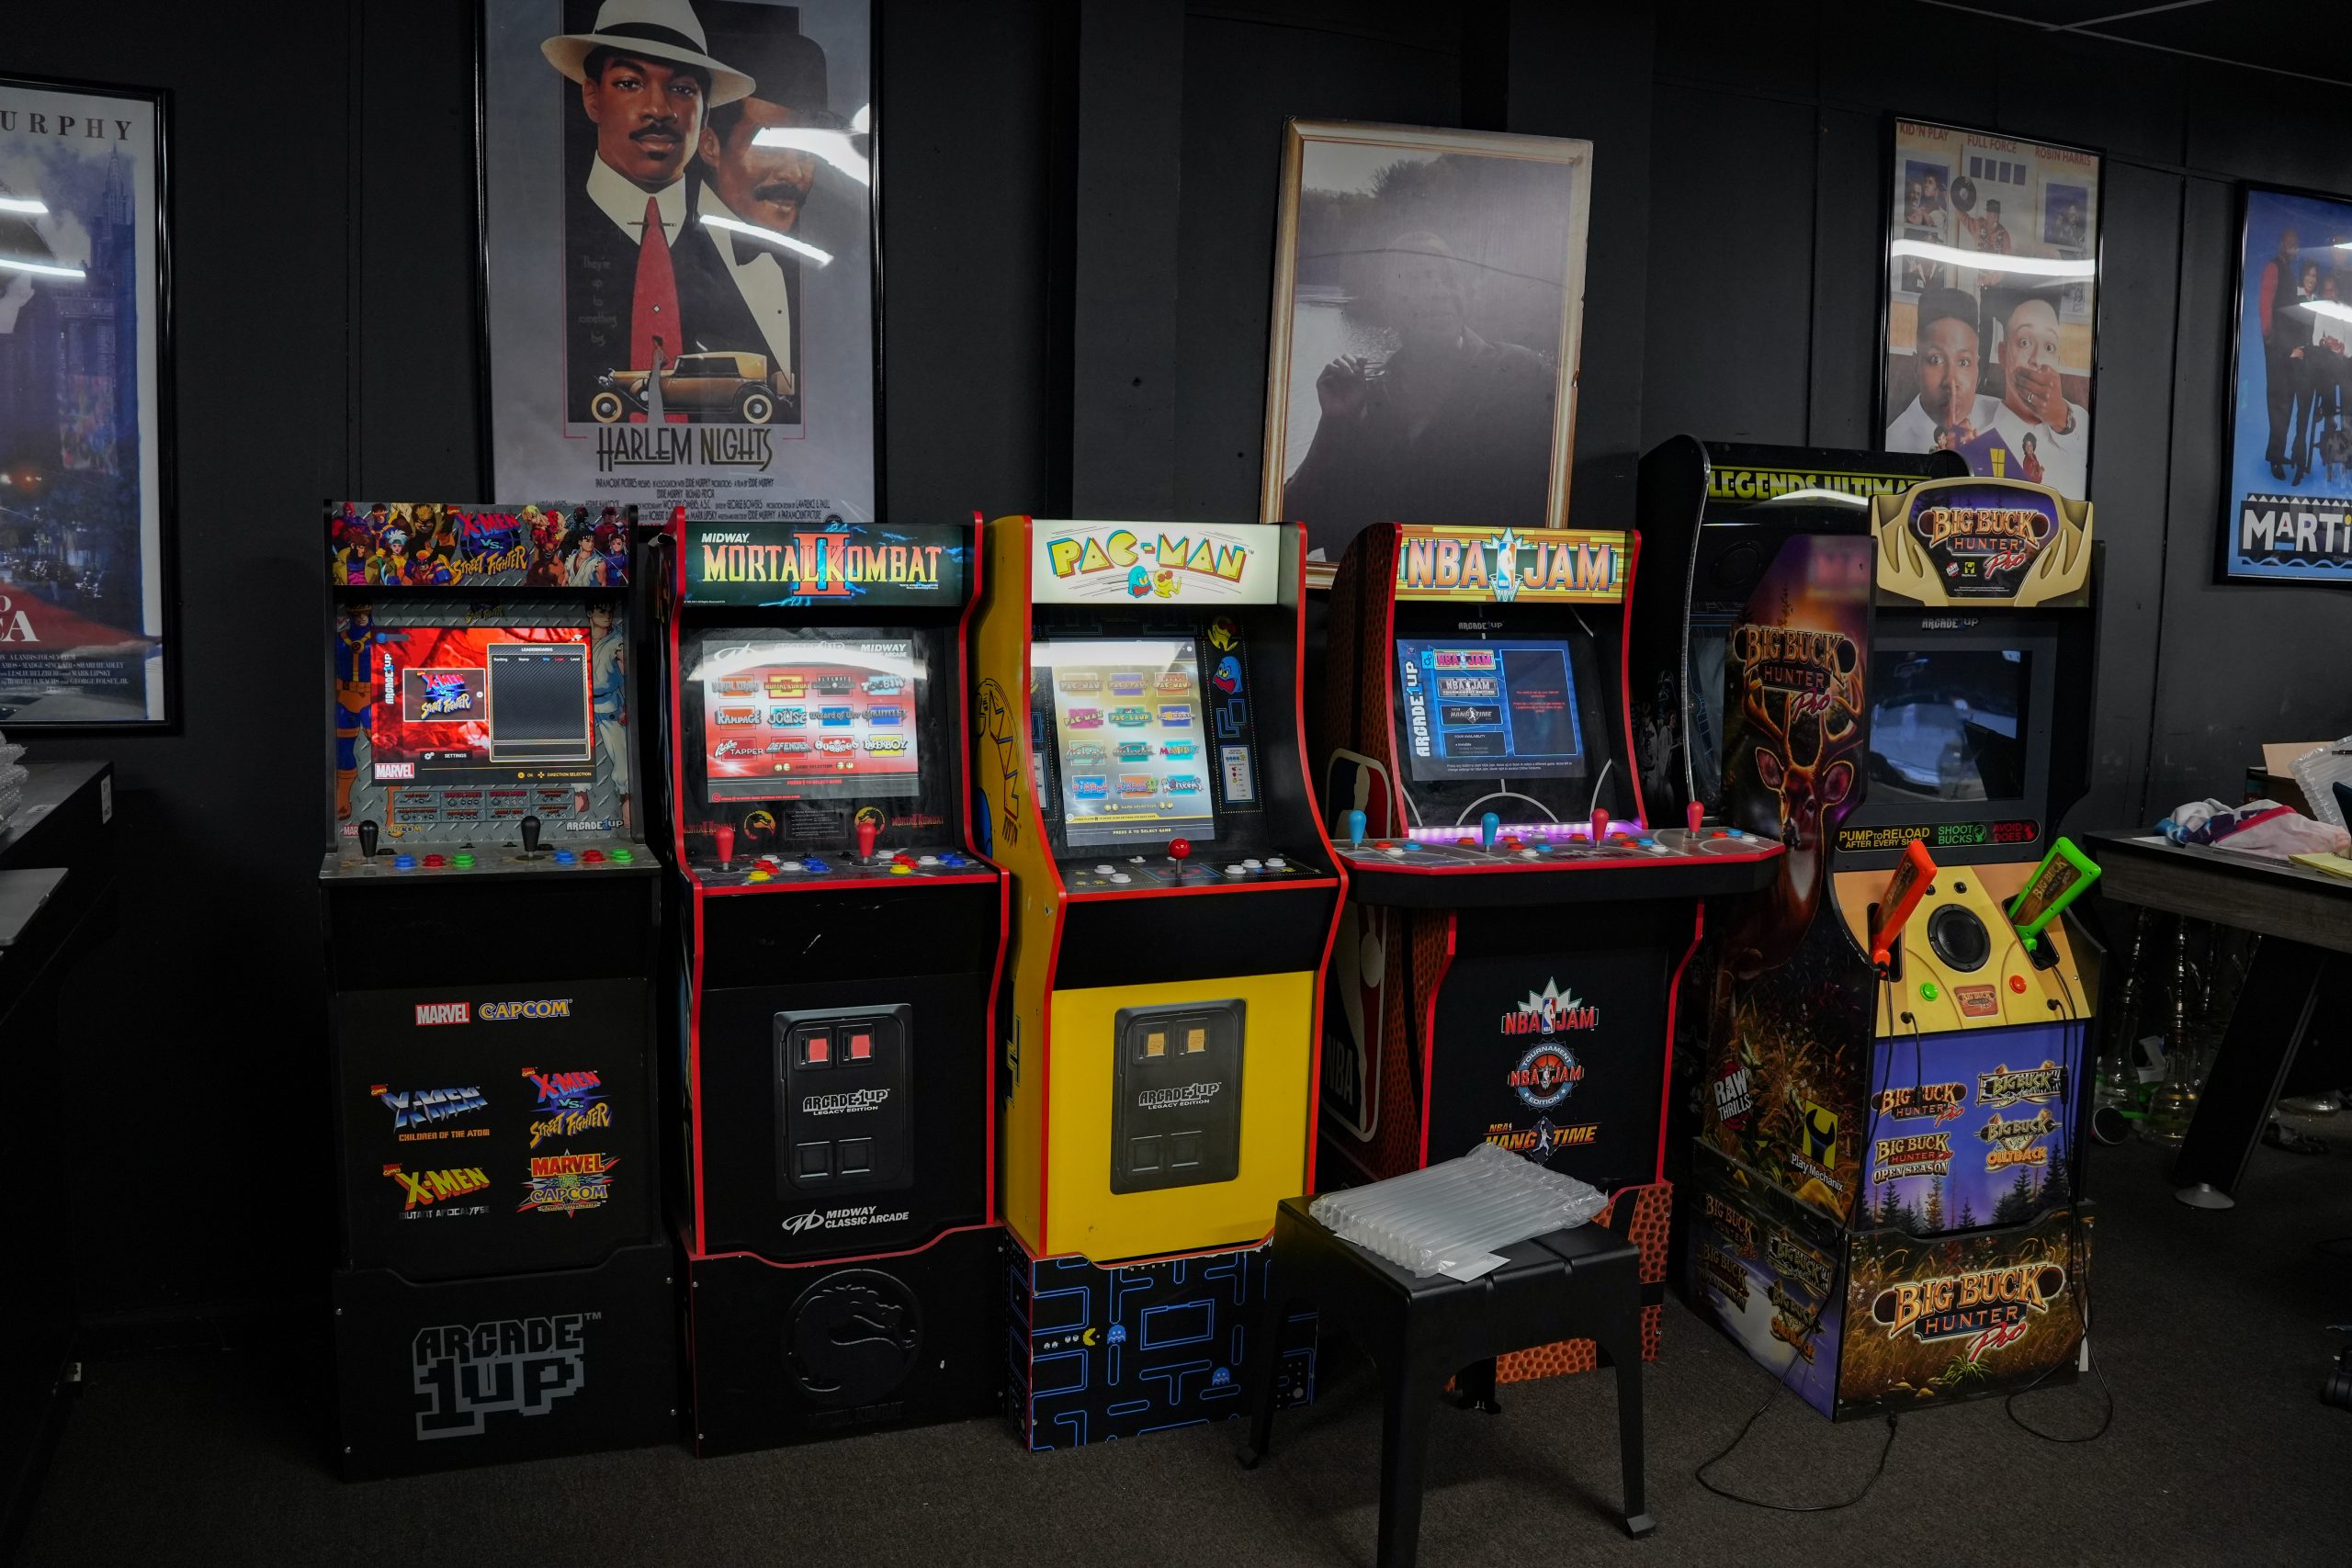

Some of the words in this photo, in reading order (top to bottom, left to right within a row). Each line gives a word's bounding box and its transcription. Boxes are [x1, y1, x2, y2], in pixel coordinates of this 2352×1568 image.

[1899, 123, 1915, 135] KID
[1928, 128, 1949, 141] PLAY
[1967, 135, 1987, 148] FULL
[1989, 139, 2018, 153] FORCE
[2035, 147, 2061, 161] ROBIN
[2063, 152, 2092, 166] HARRIS
[596, 427, 692, 471] HARLEM
[701, 427, 773, 471] NIGHTS
[1708, 470, 1816, 500] LEGENDS
[456, 513, 521, 540] X-MEN
[1930, 508, 1973, 547] BIG
[1975, 509, 2039, 547] BUCK
[480, 538, 503, 549] VS.
[1954, 538, 2018, 550] HUNTER
[451, 551, 487, 585] STREET
[487, 545, 528, 576] FIGHTER
[701, 544, 822, 581] MORTAL
[823, 545, 942, 582] KOMBAT
[1046, 529, 1247, 584] PAC-MAN
[1407, 538, 1490, 590] NBA
[1523, 542, 1612, 591] JAM
[1984, 550, 2025, 578] Pro
[1458, 620, 1504, 630] ARCADE1UP
[1921, 617, 1979, 630] ARCADE1UP
[861, 644, 907, 652] MIDWAY
[1436, 652, 1459, 666] NBA
[1468, 652, 1492, 666] JAM
[1745, 626, 1782, 676] BIG
[1782, 629, 1847, 691] BUCK
[384, 652, 395, 705] ARCADE1UP
[422, 674, 466, 691] X-MEN
[1445, 680, 1466, 691] NBA
[1471, 681, 1490, 691] JAM
[1764, 665, 1825, 689] HUNTER
[421, 697, 443, 720] STREET
[444, 694, 472, 714] FIGHTER
[1405, 660, 1430, 757] ARCADE1UP
[1791, 687, 1831, 721] Pro
[715, 710, 762, 725] RAMPAGE
[729, 748, 763, 756] TAPPER
[766, 741, 812, 753] DEFENDER
[864, 740, 908, 751] PAPERBOY
[376, 764, 413, 778] MARVEL
[566, 819, 623, 831] ARCADE1UP
[1839, 829, 1872, 842] PUMP
[1883, 828, 1930, 840] RELOAD
[1938, 825, 1973, 836] SHOOT
[1993, 823, 2021, 834] AVOID
[1846, 840, 1872, 848] AFTER
[1873, 838, 1900, 847] EVERY
[1901, 838, 1923, 846] SH
[1939, 835, 1973, 845] BUCKS
[1995, 831, 2021, 842] DOES
[416, 1003, 469, 1025] MARVEL
[479, 998, 571, 1021] CAPCOM
[1504, 1010, 1541, 1035] NBA
[1555, 1006, 1596, 1031] JAM
[1521, 1045, 1572, 1066] TOURNAMENT
[1324, 1032, 1353, 1106] NBA
[1510, 1068, 1540, 1088] NBA
[1551, 1065, 1582, 1084] JAM
[529, 1070, 602, 1102] X-MEN
[1138, 1082, 1220, 1107] ARCADE1UP
[1713, 1067, 1750, 1106] RAW
[1993, 1077, 2015, 1095] BIG
[2015, 1074, 2052, 1089] BUCK
[380, 1087, 488, 1133] X-MEN
[558, 1098, 584, 1109] VS.
[802, 1089, 888, 1113] ARCADE1UP
[813, 1108, 844, 1116] LEGACY
[846, 1105, 879, 1113] EDITION
[1180, 1099, 1210, 1107] EDITION
[1528, 1094, 1560, 1105] EDITION
[1717, 1094, 1752, 1122] THRILLS
[1879, 1089, 1911, 1118] BIG
[1920, 1082, 1959, 1106] UCK
[1895, 1104, 1944, 1117] HUNTER
[529, 1111, 567, 1150] STREET
[566, 1102, 612, 1137] FIGHTER
[1488, 1122, 1510, 1133] NBA
[1934, 1106, 1964, 1128] Pro
[398, 1132, 437, 1142] CHILDREN
[439, 1131, 449, 1139] OF
[451, 1130, 465, 1138] THE
[467, 1128, 491, 1137] ATOM
[1553, 1125, 1598, 1145] TIME
[1986, 1123, 2011, 1142] BIG
[2011, 1117, 2048, 1136] BUCK
[1875, 1140, 1905, 1167] BIG
[1905, 1132, 1951, 1154] BUCK
[1891, 1151, 1934, 1163] HUNTER
[1985, 1147, 2048, 1166] OUTBACK
[530, 1153, 605, 1178] MARVEL
[1791, 1153, 1809, 1176] Play
[1808, 1164, 1844, 1192] Mechanix
[1872, 1168, 1905, 1184] OPEN
[1905, 1161, 1949, 1177] SEASON
[394, 1167, 491, 1212] X-MEN
[530, 1184, 608, 1203] CAPCOM
[825, 1216, 877, 1230] CLASSIC
[877, 1211, 919, 1225] ARCADE
[826, 1205, 877, 1220] MIDWAY
[1890, 1279, 1953, 1337] BIG
[1958, 1263, 2048, 1312] BUCK
[1925, 1305, 2018, 1335] HUNTER
[413, 1314, 584, 1366] ARCADE
[1967, 1321, 2028, 1363] Pro
[414, 1354, 584, 1440] 1UP
